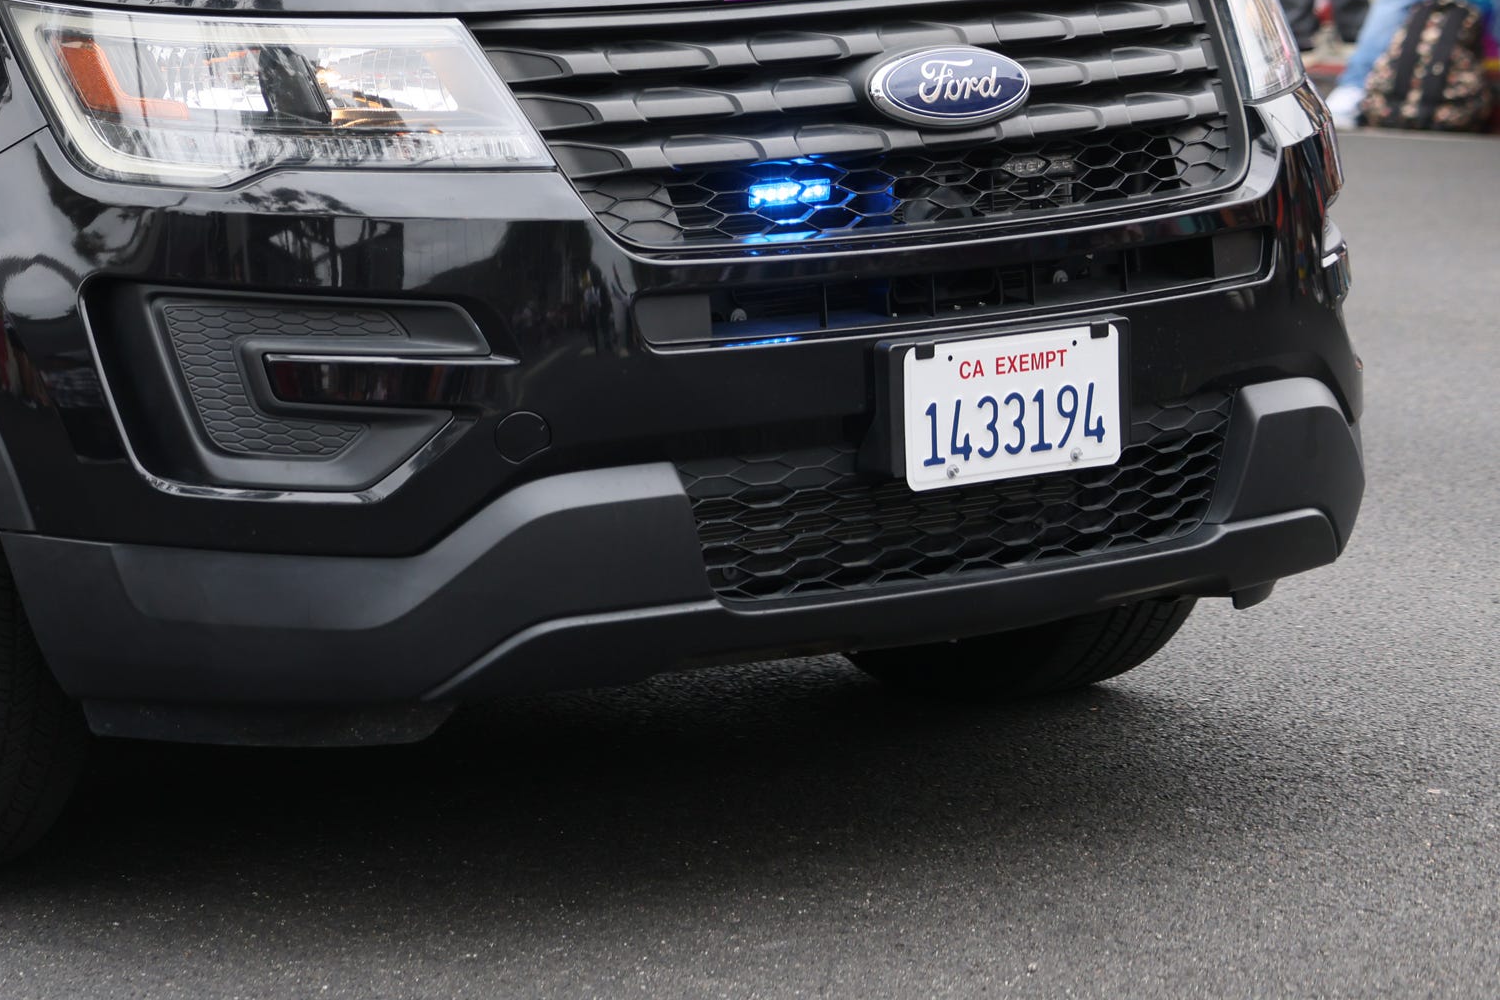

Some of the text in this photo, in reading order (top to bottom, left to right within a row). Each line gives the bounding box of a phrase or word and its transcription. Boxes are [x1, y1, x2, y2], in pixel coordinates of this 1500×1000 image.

[918, 58, 1003, 102] Ford
[958, 348, 1068, 380] CA EXEMPT
[922, 381, 1106, 468] 1433194
